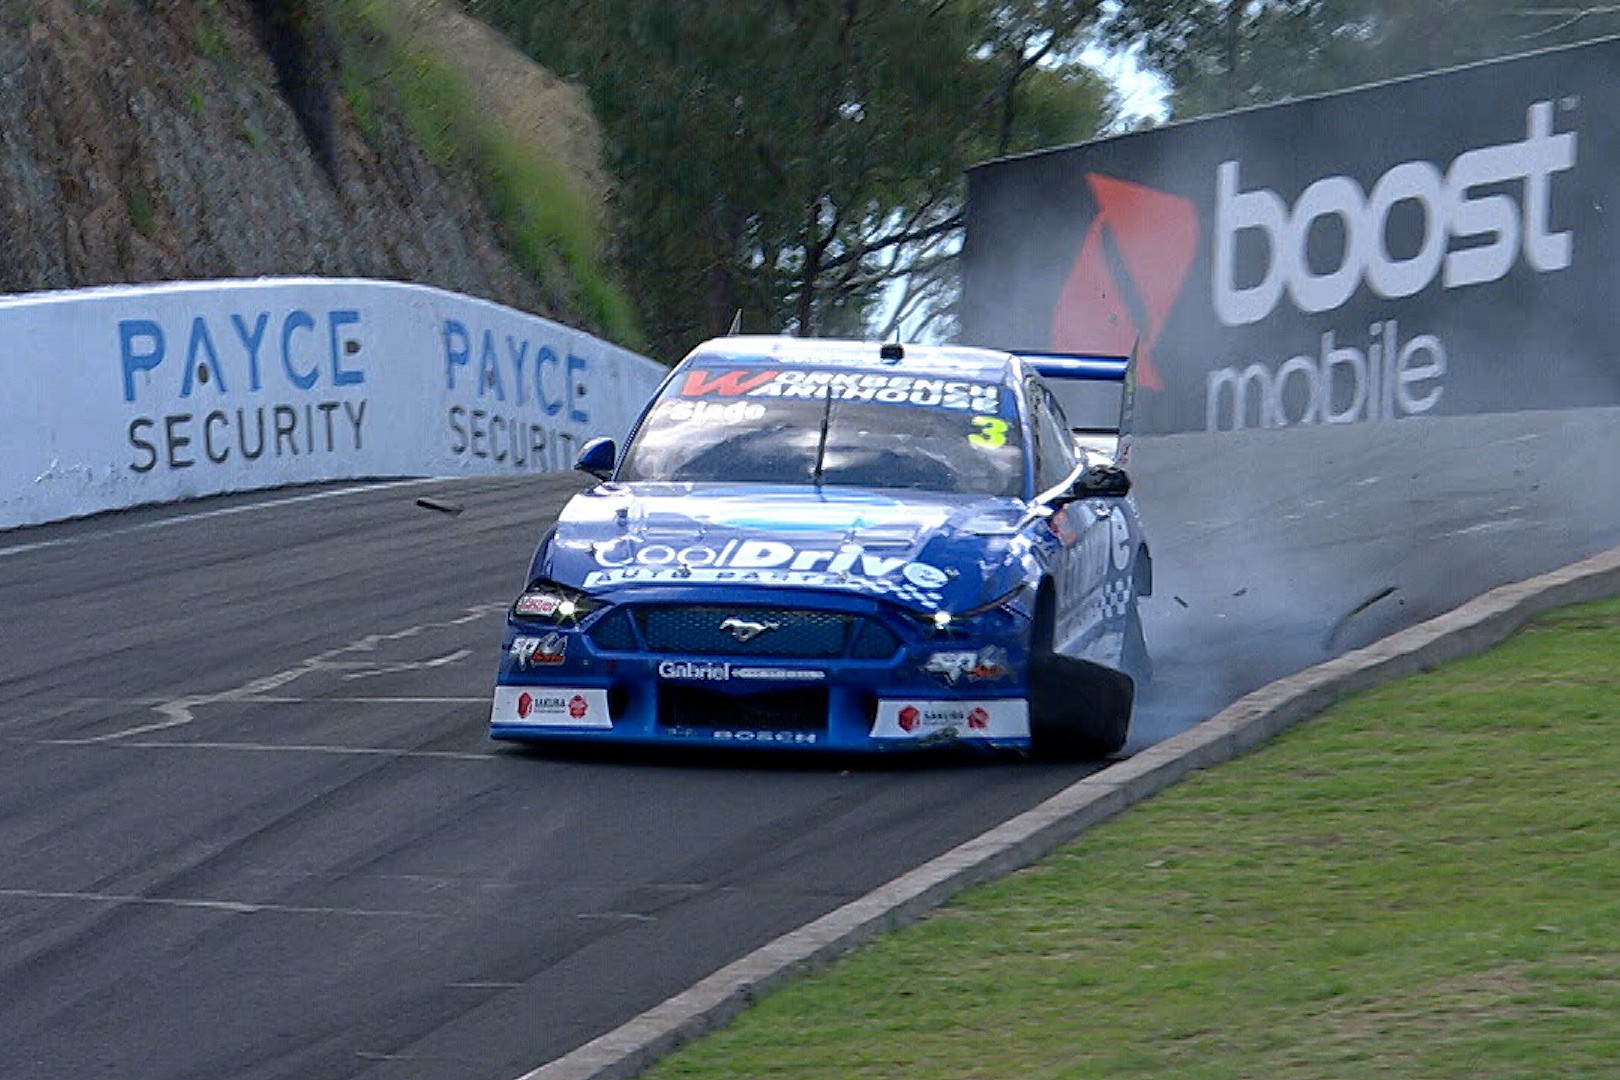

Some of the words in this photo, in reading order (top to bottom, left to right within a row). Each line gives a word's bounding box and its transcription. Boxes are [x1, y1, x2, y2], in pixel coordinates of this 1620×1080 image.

[1212, 99, 1578, 327] boost
[118, 309, 368, 403] PAYCE
[442, 319, 588, 423] PAYCE
[1205, 318, 1447, 431] mobile
[128, 399, 368, 474] SECURITY
[967, 415, 1009, 448] 3
[658, 659, 732, 681] Gabriel
